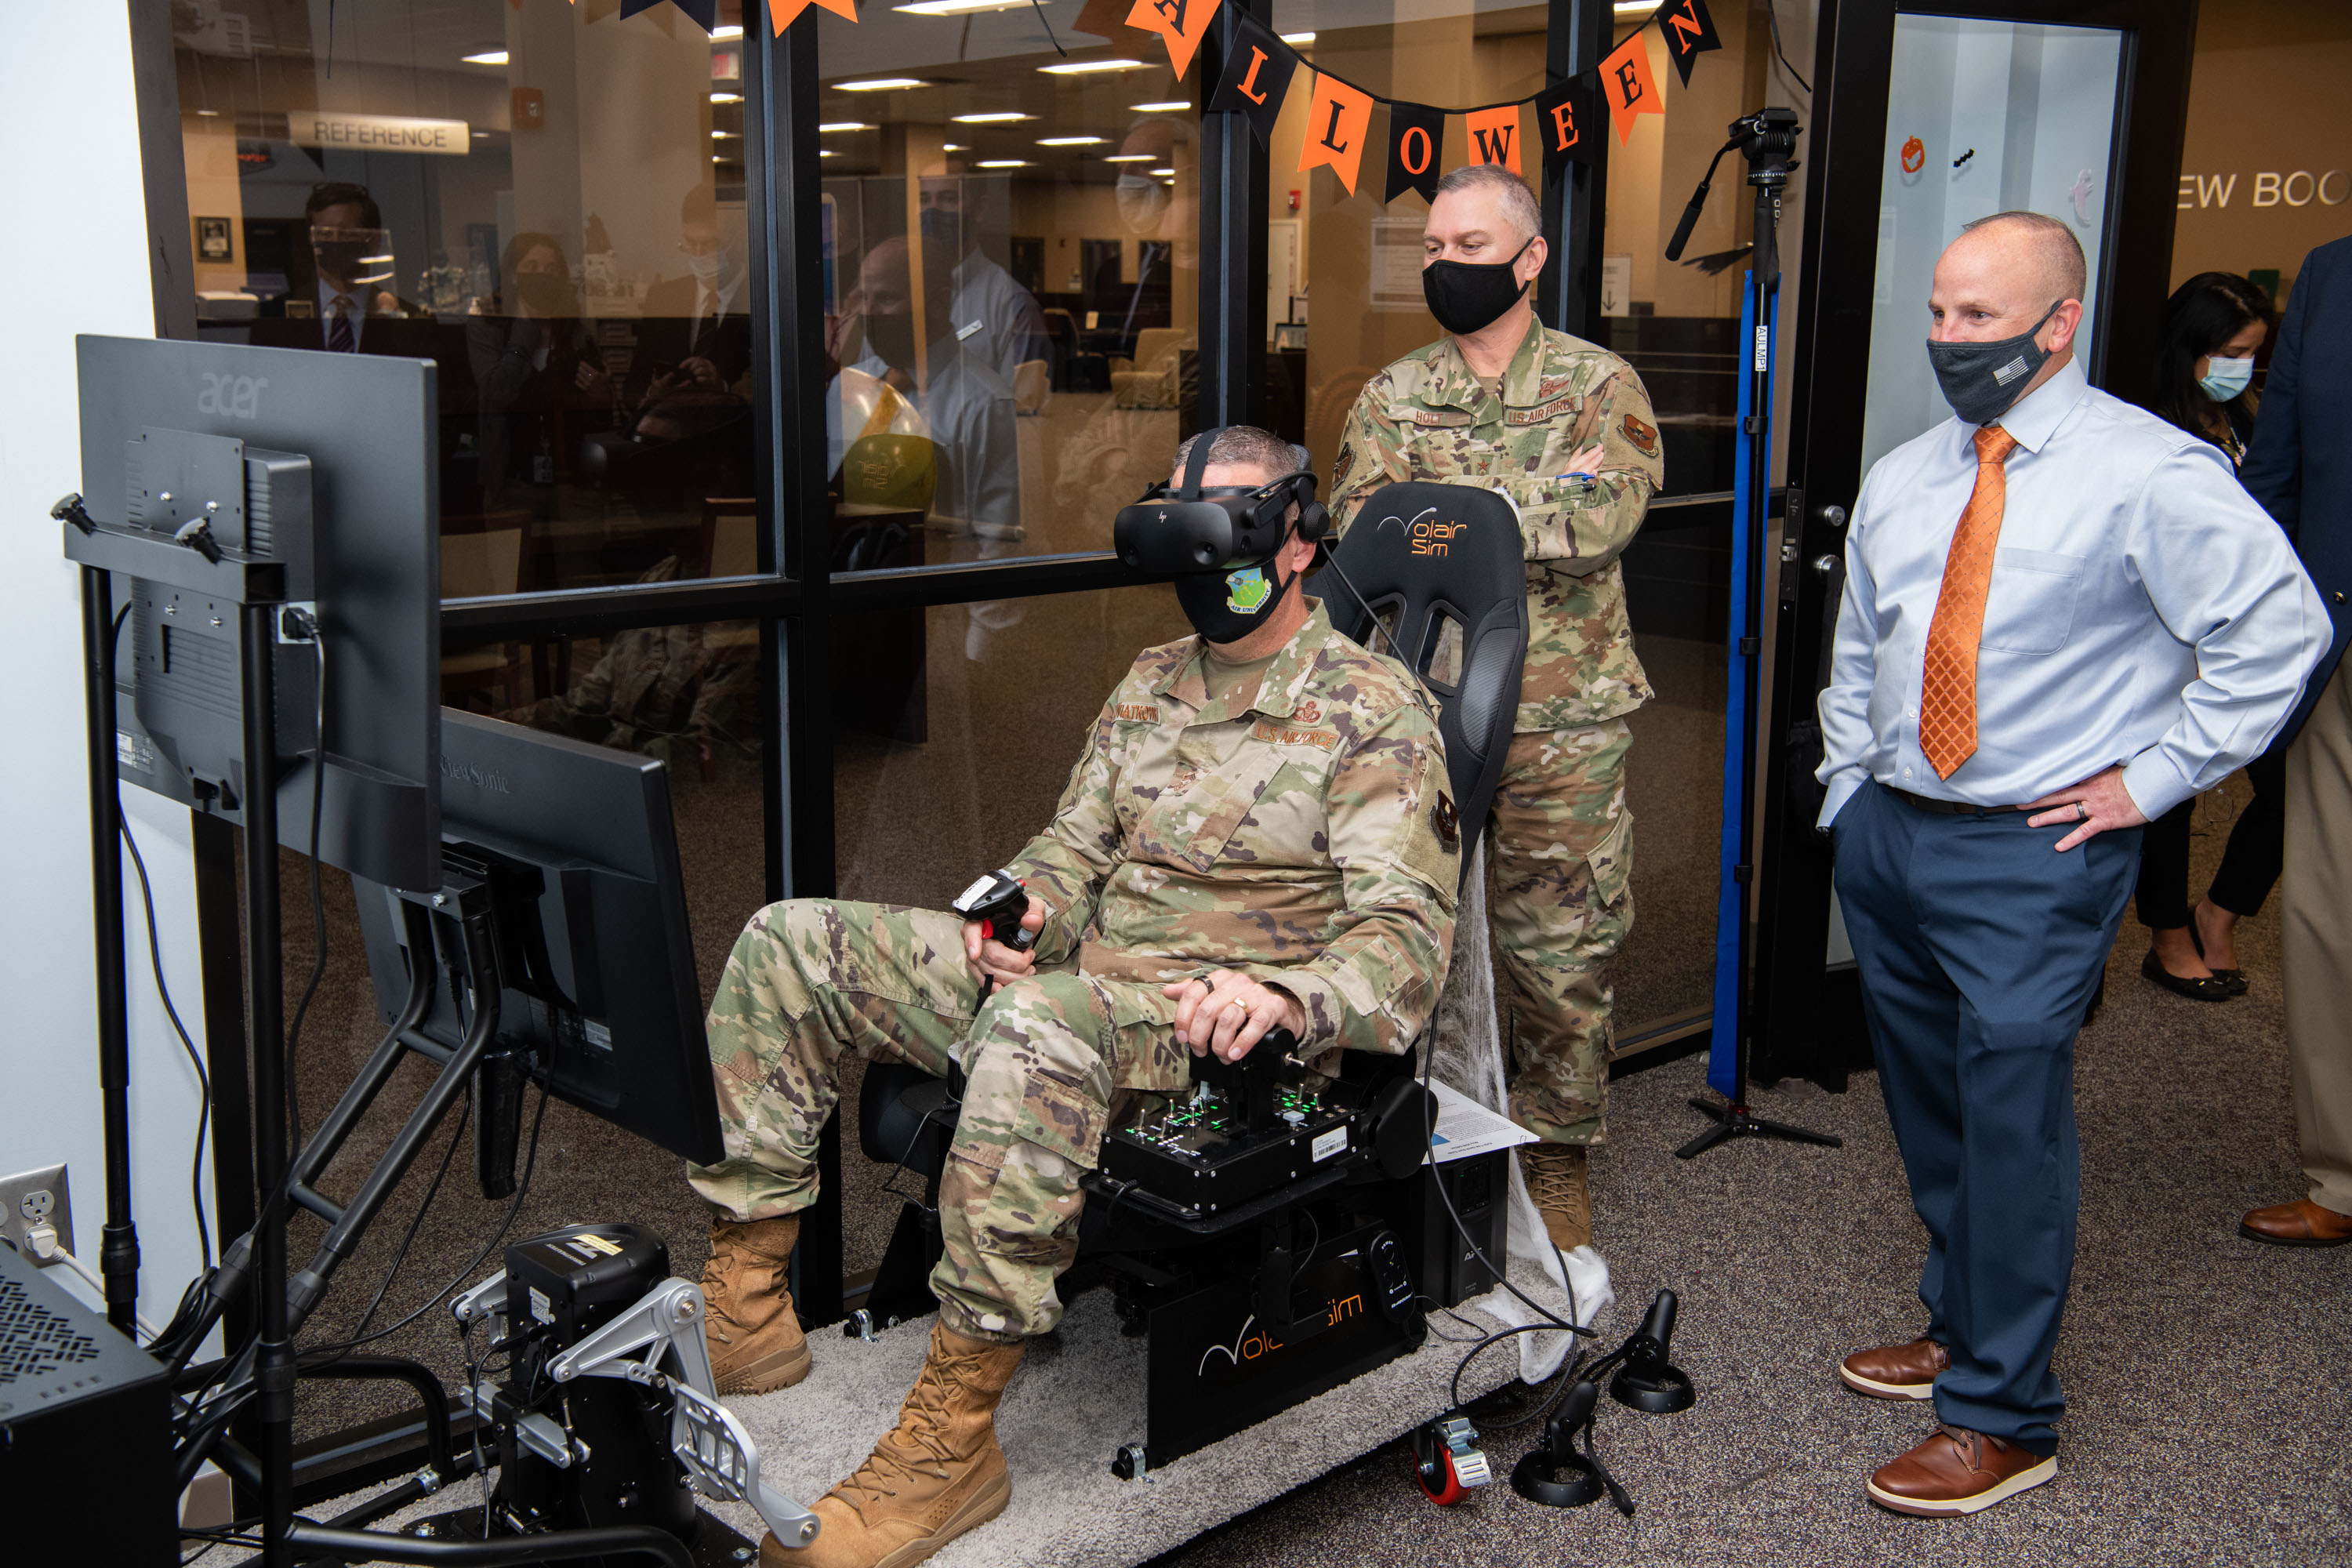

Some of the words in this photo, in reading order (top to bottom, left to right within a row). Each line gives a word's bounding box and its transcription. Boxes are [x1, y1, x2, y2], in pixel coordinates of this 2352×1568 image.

[314, 122, 447, 147] REFERENCE
[1757, 327, 1766, 370] AULMP1
[198, 372, 269, 419] acer
[1416, 410, 1443, 424] HOLT
[1528, 408, 1544, 423] AIR
[1545, 397, 1577, 417] FORCE
[1377, 506, 1467, 539] Volair
[1411, 539, 1448, 557] Sim
[1242, 588, 1270, 612] UNIVERSITY
[1257, 724, 1277, 742] U.S.
[1279, 730, 1298, 744] AIR
[1298, 730, 1335, 749] FORCE
